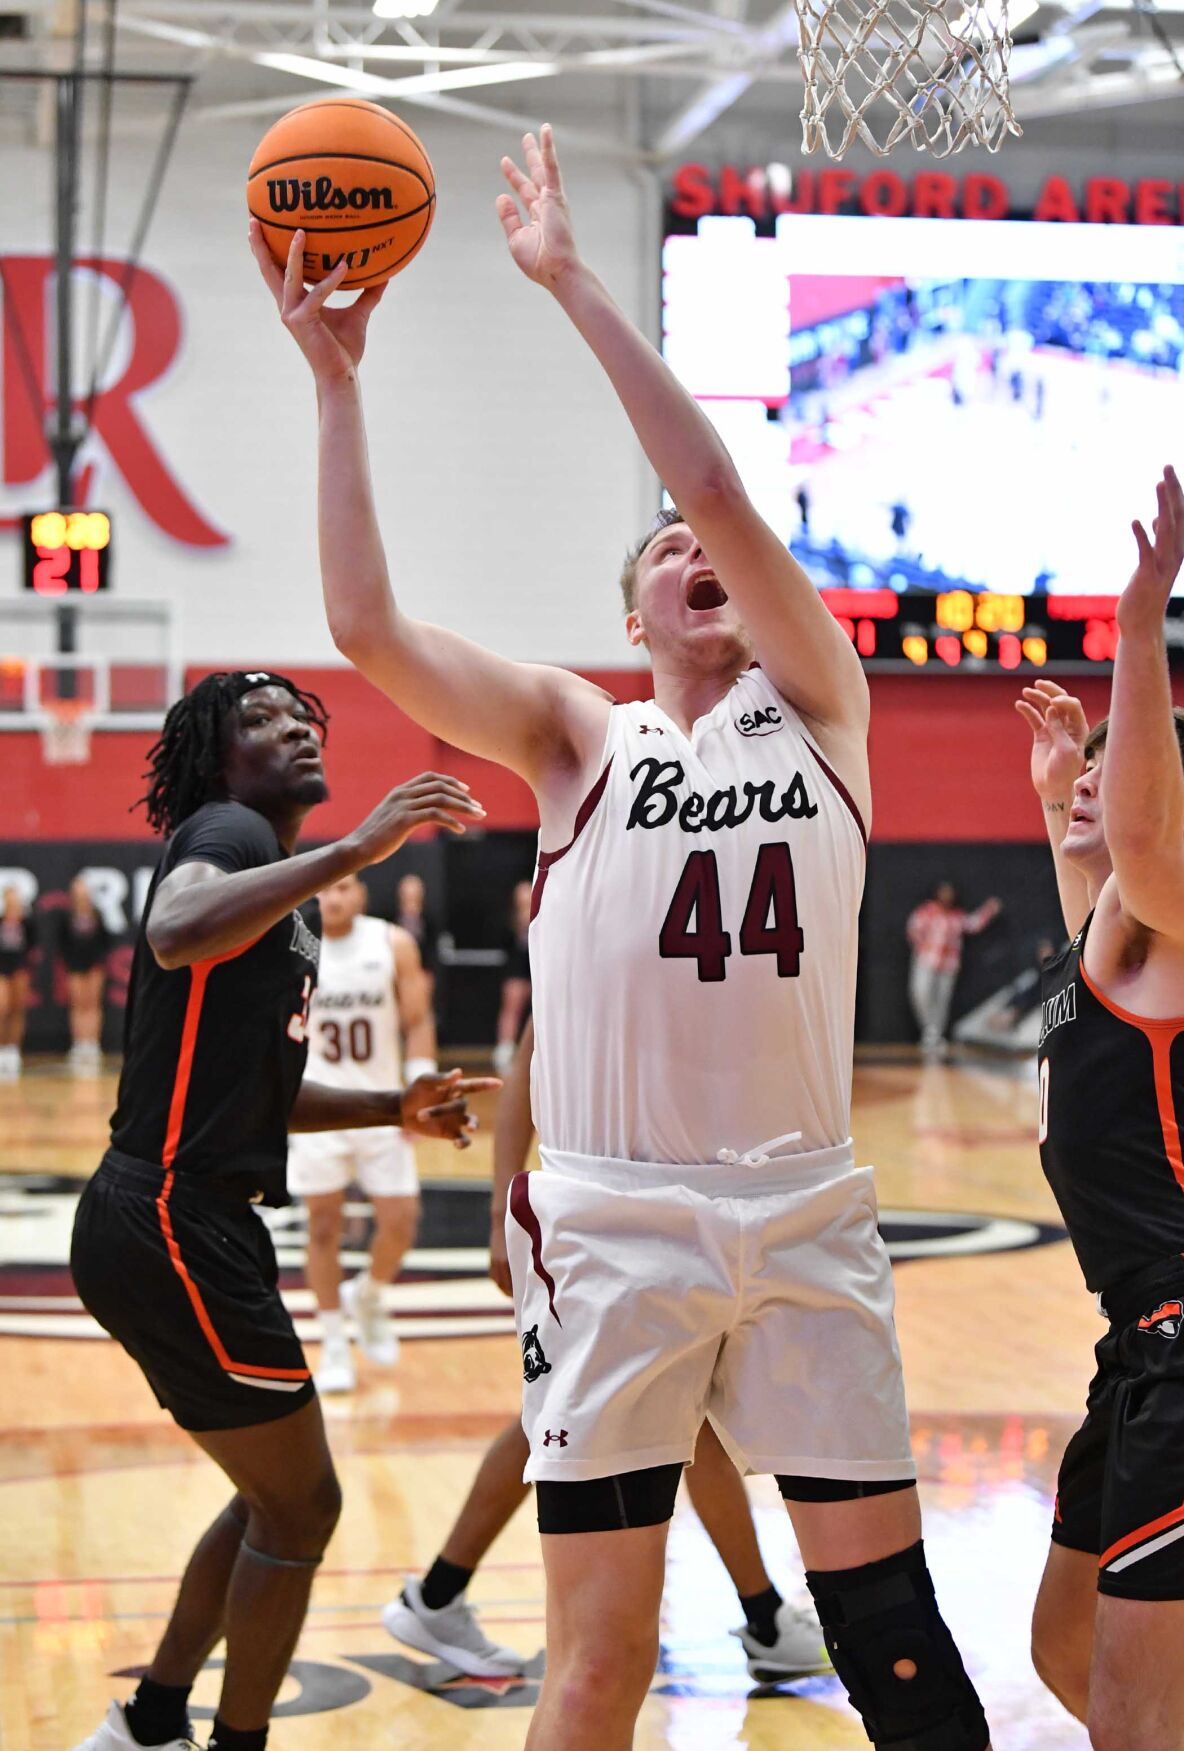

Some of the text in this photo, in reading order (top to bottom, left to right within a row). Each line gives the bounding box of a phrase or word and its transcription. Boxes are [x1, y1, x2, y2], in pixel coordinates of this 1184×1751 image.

[267, 177, 393, 212] Wilson
[672, 164, 1184, 225] SHUFORD ARE
[740, 706, 782, 732] SAC
[626, 757, 818, 833] Bears
[659, 842, 804, 982] 44
[319, 1017, 373, 1063] 30
